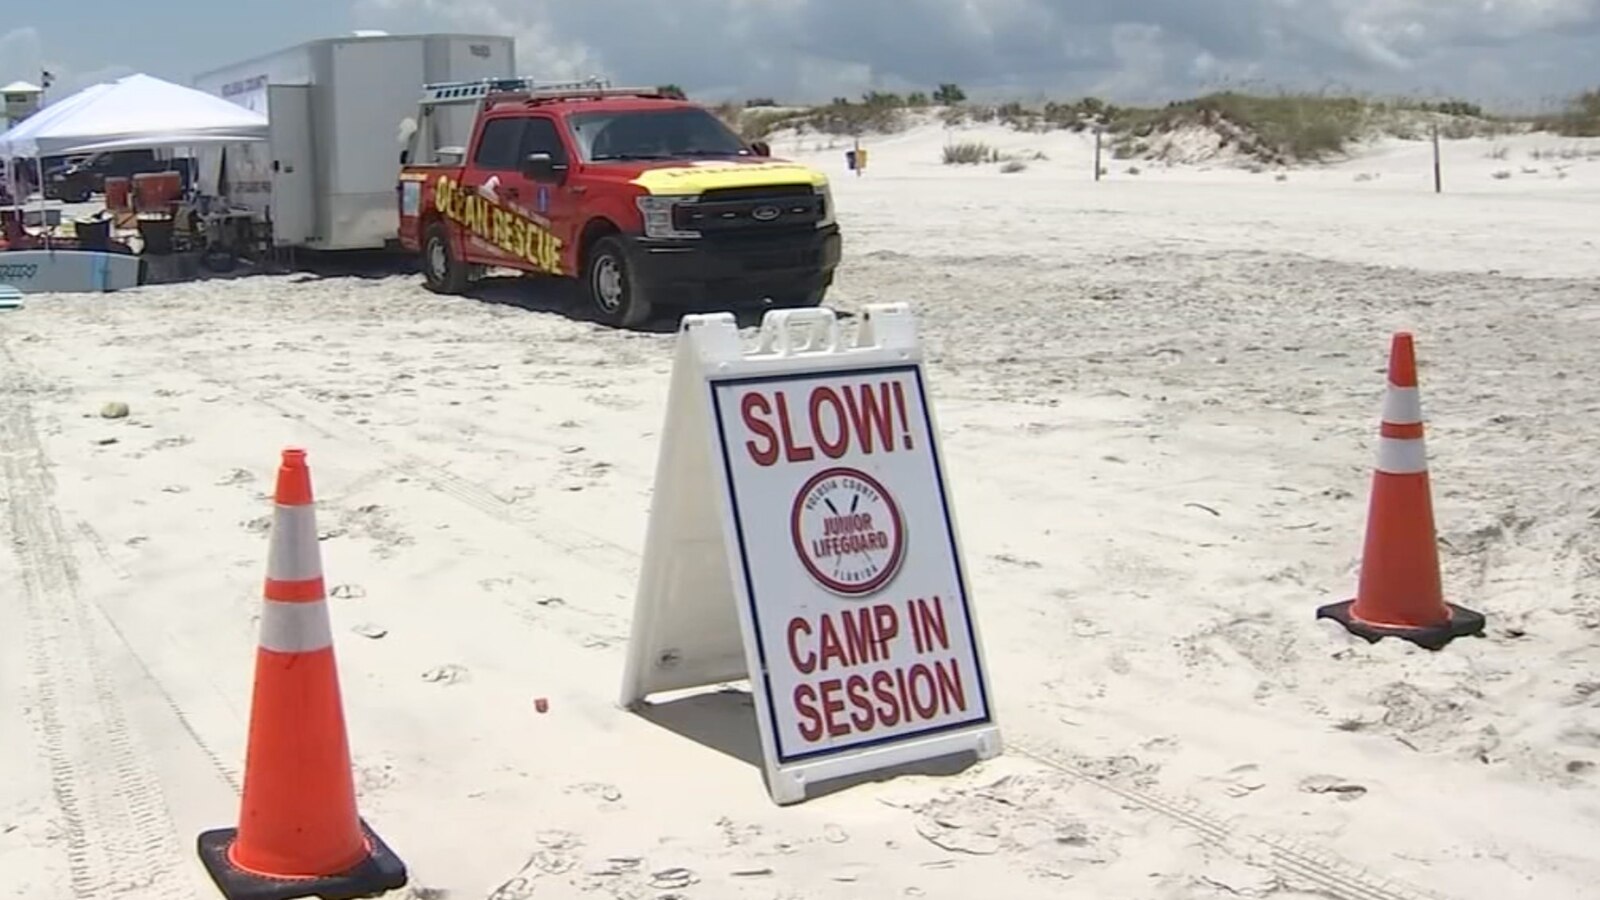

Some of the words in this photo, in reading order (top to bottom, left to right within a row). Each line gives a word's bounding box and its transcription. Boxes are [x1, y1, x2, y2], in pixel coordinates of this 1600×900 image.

[435, 174, 489, 240] OCEAN
[492, 206, 563, 276] RESCUE
[740, 380, 914, 467] SLOW!
[805, 480, 838, 511] VOLUSIA
[841, 478, 880, 503] COUNTY
[812, 531, 889, 558] LIFEGUARD
[823, 512, 874, 537] JUNIOR
[833, 563, 879, 582] FLORIDA
[786, 603, 899, 675] CAMP
[906, 595, 950, 655] IN
[792, 657, 967, 743] SESSION
